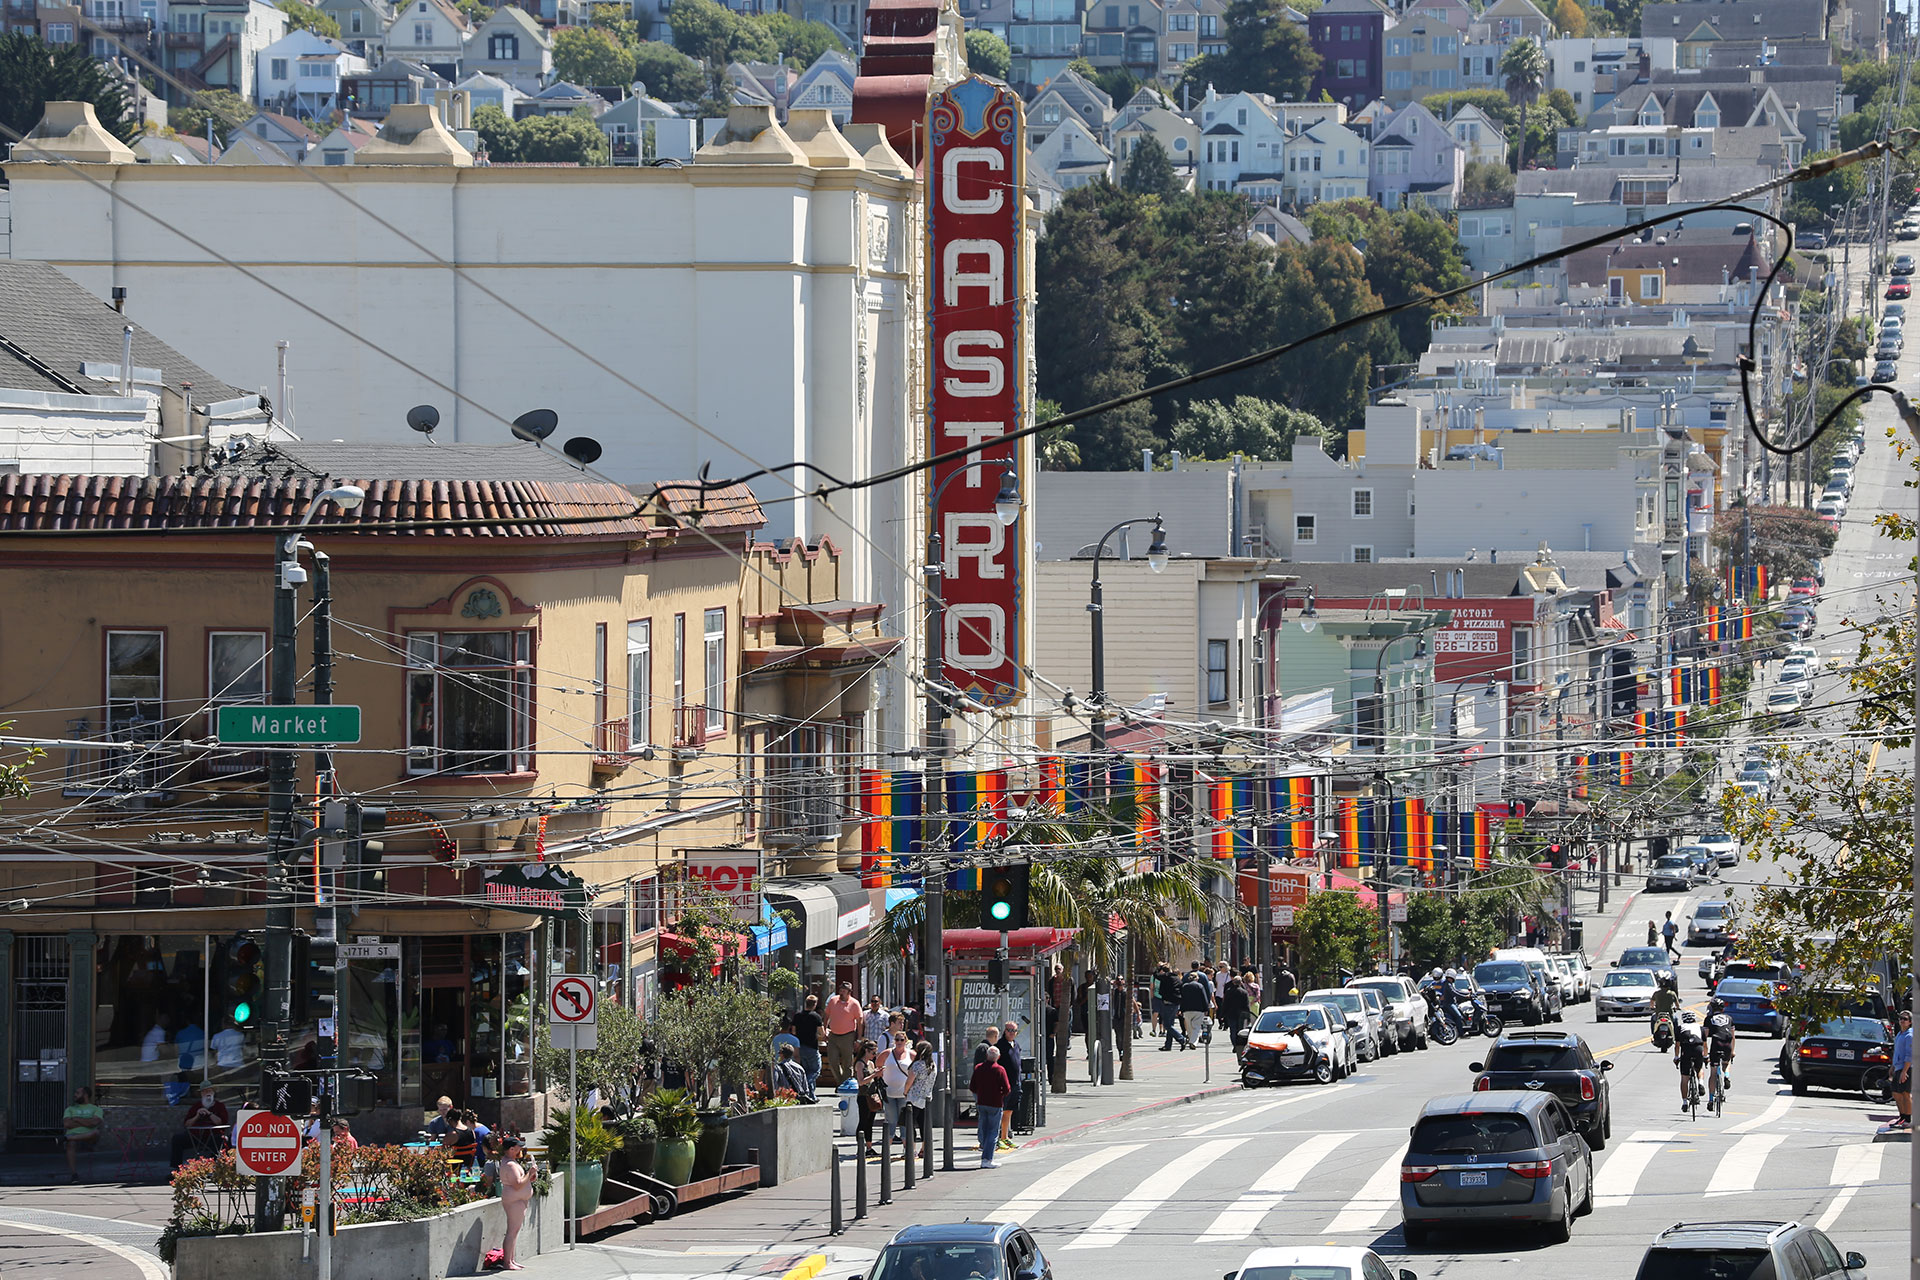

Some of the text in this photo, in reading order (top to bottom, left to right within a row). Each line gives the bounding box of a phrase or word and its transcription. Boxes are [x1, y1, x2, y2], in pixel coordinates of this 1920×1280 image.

[942, 146, 1006, 670] CASTRO
[1463, 620, 1505, 629] PIZZERIA
[1454, 632, 1467, 640] OUT
[1434, 641, 1496, 651] 626-1250
[251, 715, 328, 734] Market
[689, 866, 757, 892] HOT
[347, 947, 389, 956] 17TH ST
[964, 997, 994, 1010] YOU'RE
[963, 1011, 976, 1024] AN
[977, 1011, 1000, 1024] EASY
[247, 1123, 292, 1134] DO NOT
[250, 1151, 288, 1162] ENTER
